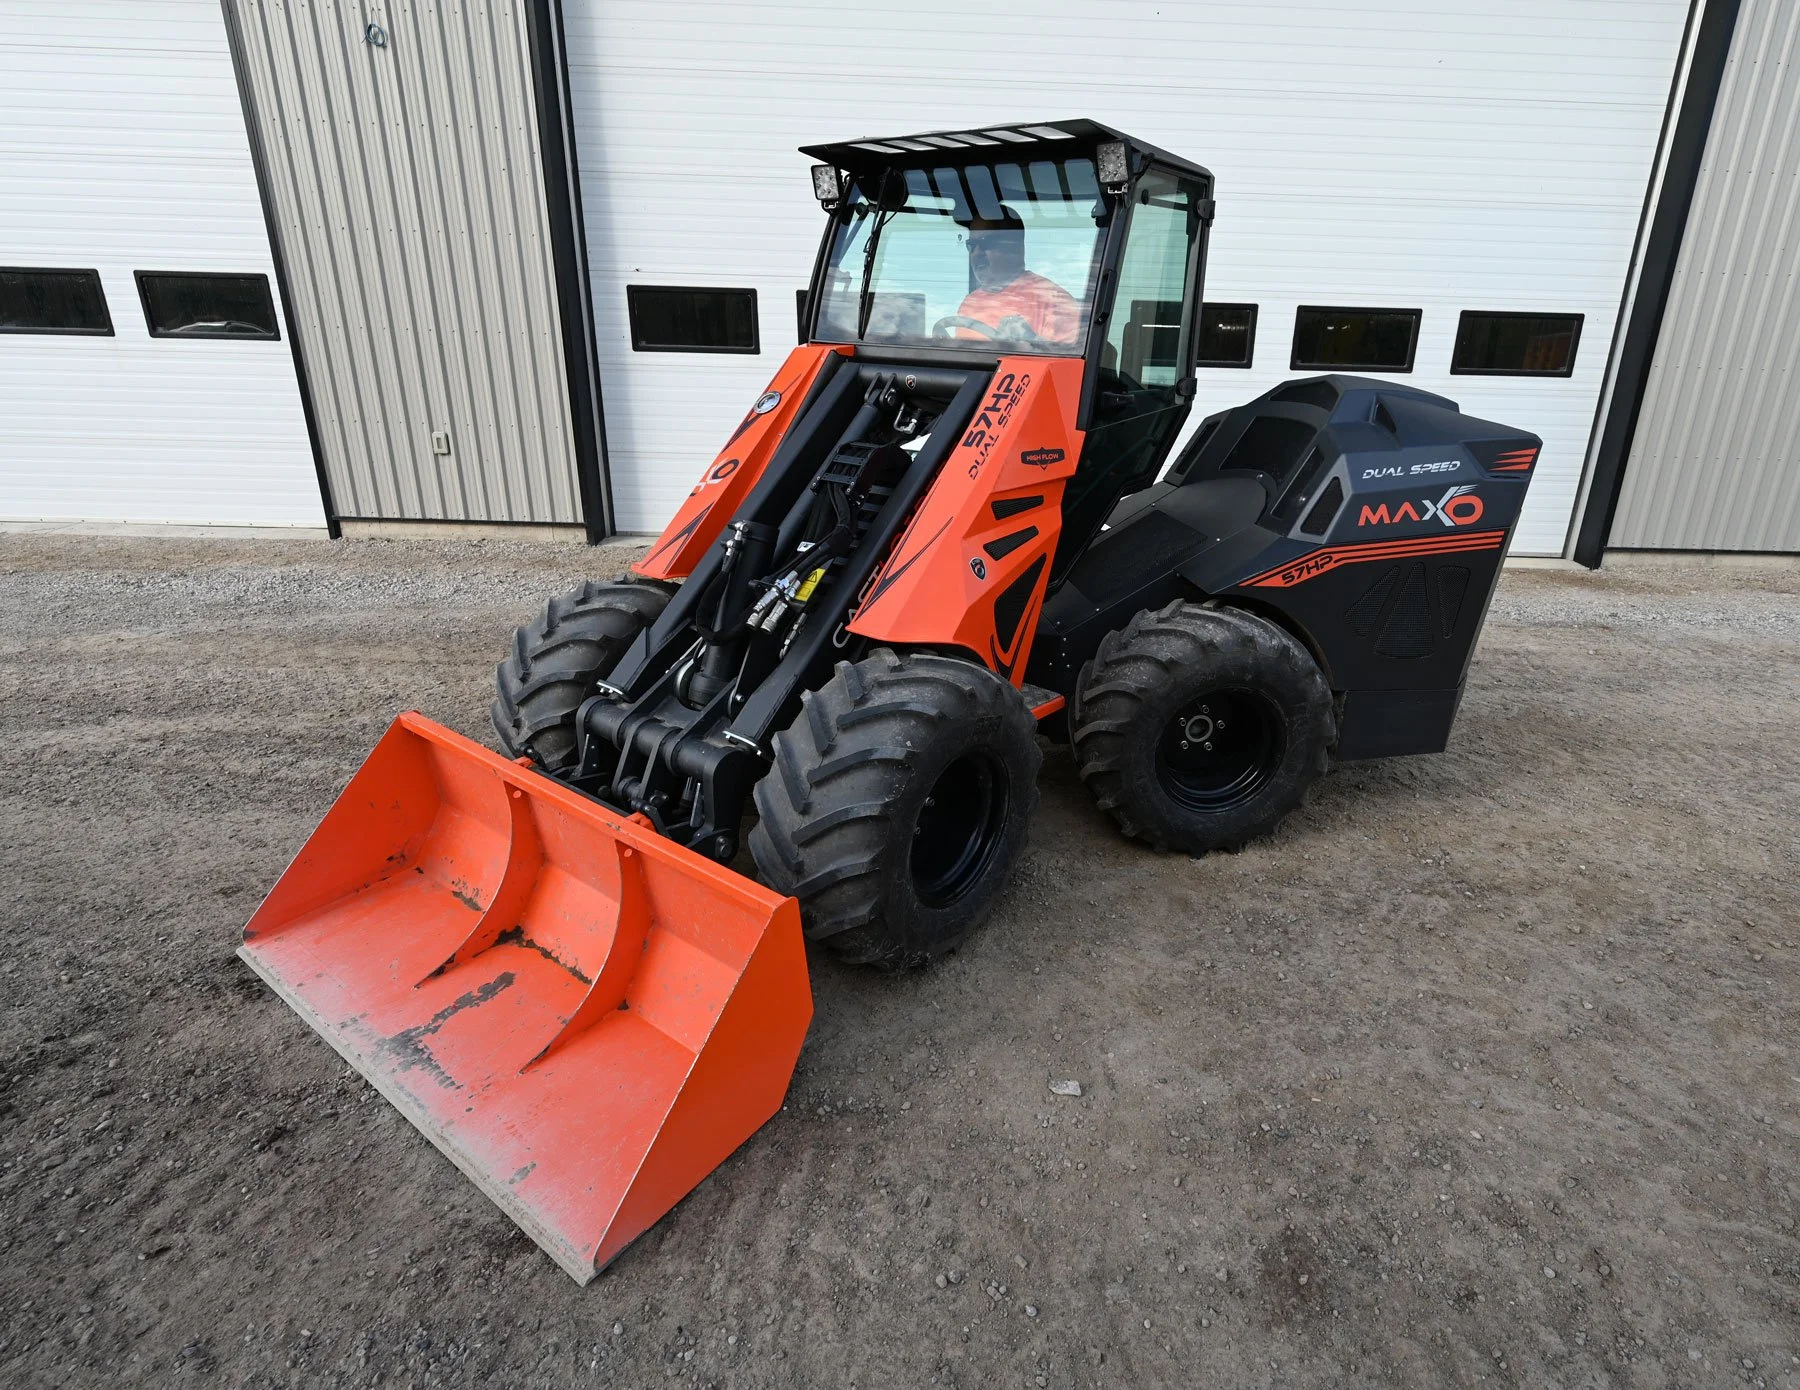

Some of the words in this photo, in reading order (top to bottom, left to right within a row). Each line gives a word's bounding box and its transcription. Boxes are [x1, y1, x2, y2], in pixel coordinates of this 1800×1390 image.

[962, 373, 1016, 448] 57HP
[968, 434, 1000, 480] DUAL
[997, 374, 1031, 428] SPEED
[1026, 454, 1041, 462] HIGH
[1041, 453, 1059, 461] FLOW
[1362, 466, 1406, 479] DUAL
[1409, 460, 1461, 475] SPEED
[1357, 485, 1484, 527] MAXO
[1281, 555, 1333, 585] 57HP
